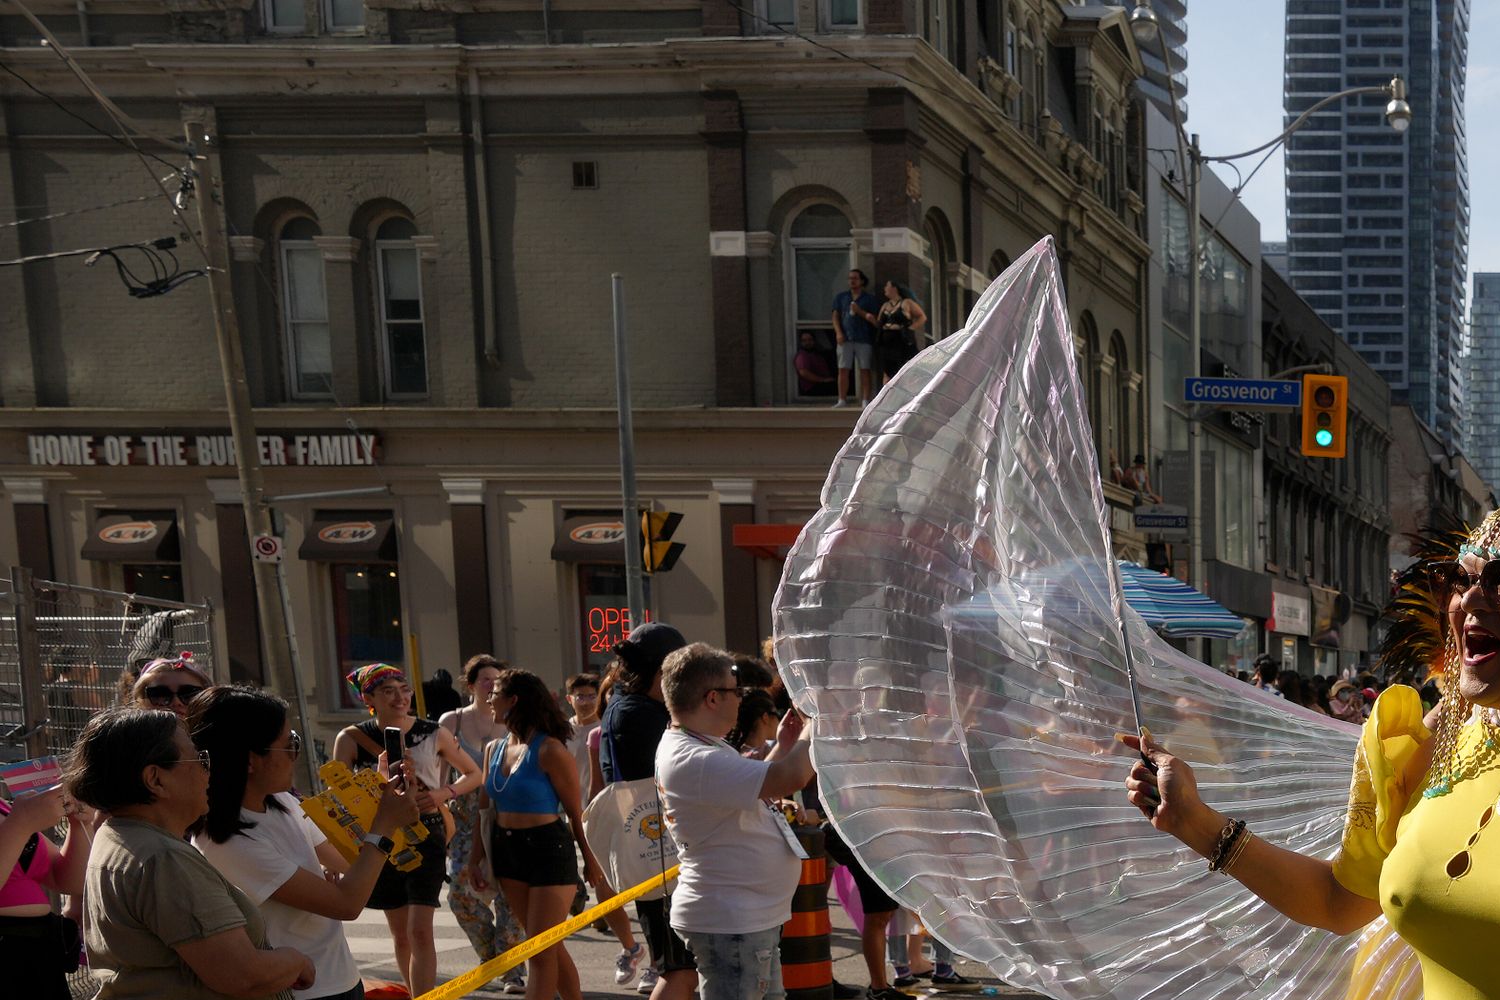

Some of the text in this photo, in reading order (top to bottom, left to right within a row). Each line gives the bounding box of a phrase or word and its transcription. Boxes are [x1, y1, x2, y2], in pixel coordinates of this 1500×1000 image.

[1192, 381, 1292, 400] Grosvenor St
[28, 435, 375, 466] HOME OF THE BURER FAMILY
[589, 607, 649, 633] OPE
